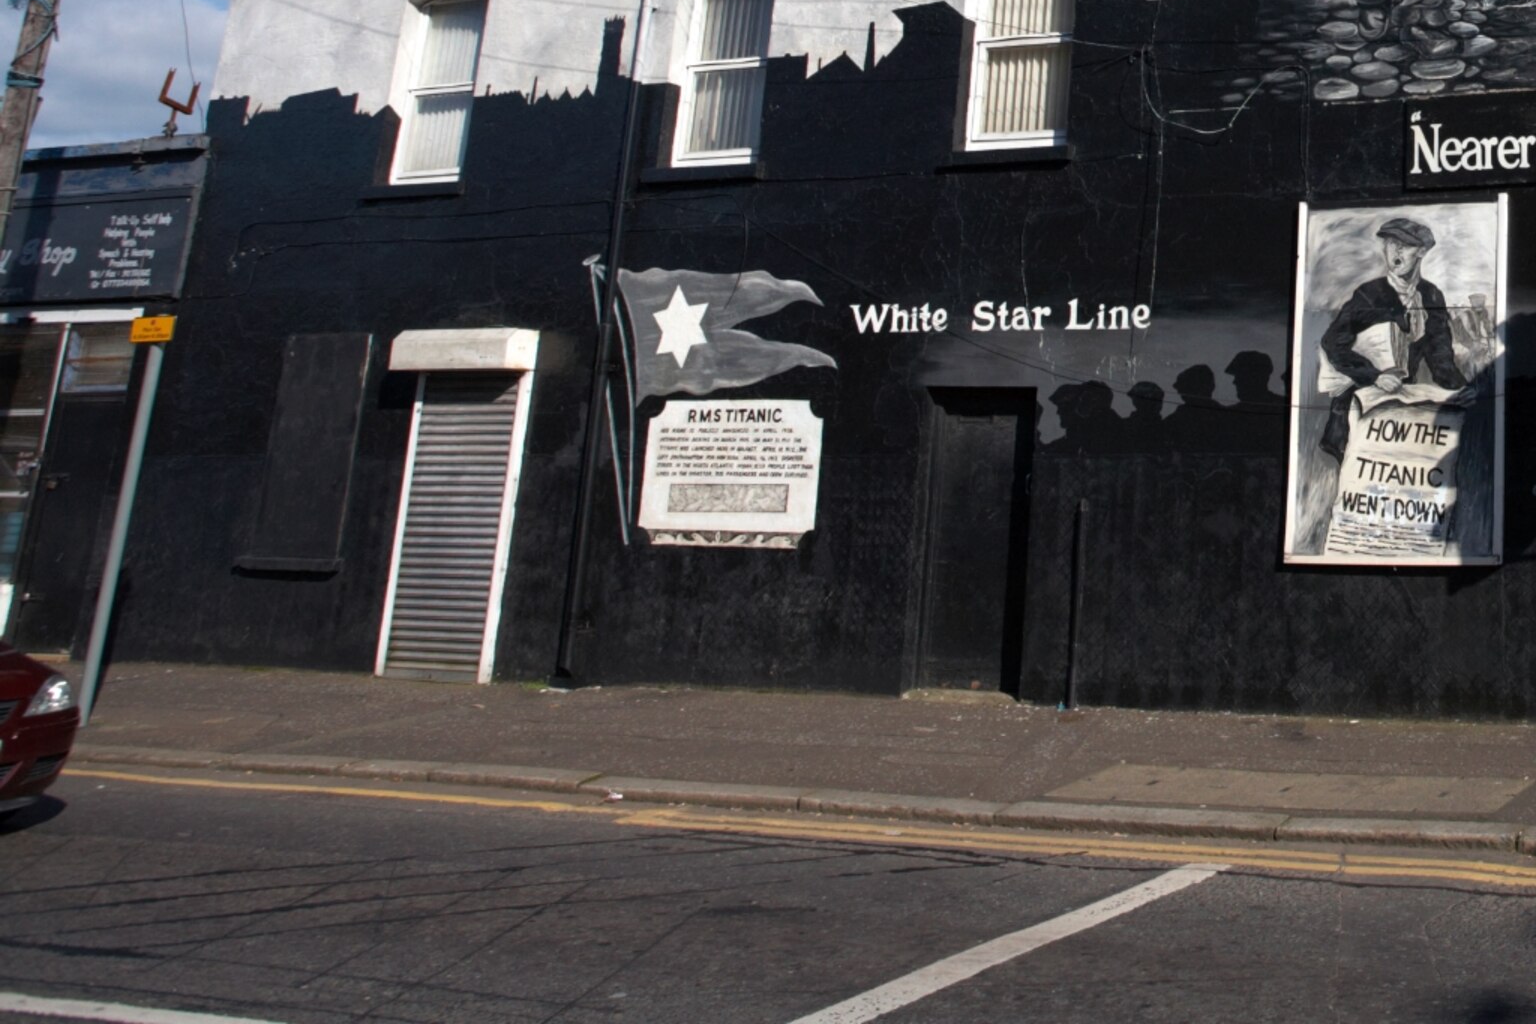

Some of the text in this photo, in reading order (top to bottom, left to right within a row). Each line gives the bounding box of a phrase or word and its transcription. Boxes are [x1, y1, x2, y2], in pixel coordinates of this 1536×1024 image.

[20, 238, 78, 276] Shop
[850, 298, 1151, 334] White Star Line
[1366, 419, 1450, 446] HOW THE
[1357, 457, 1443, 488] TITANIC
[1343, 491, 1446, 525] WENT DOWN
